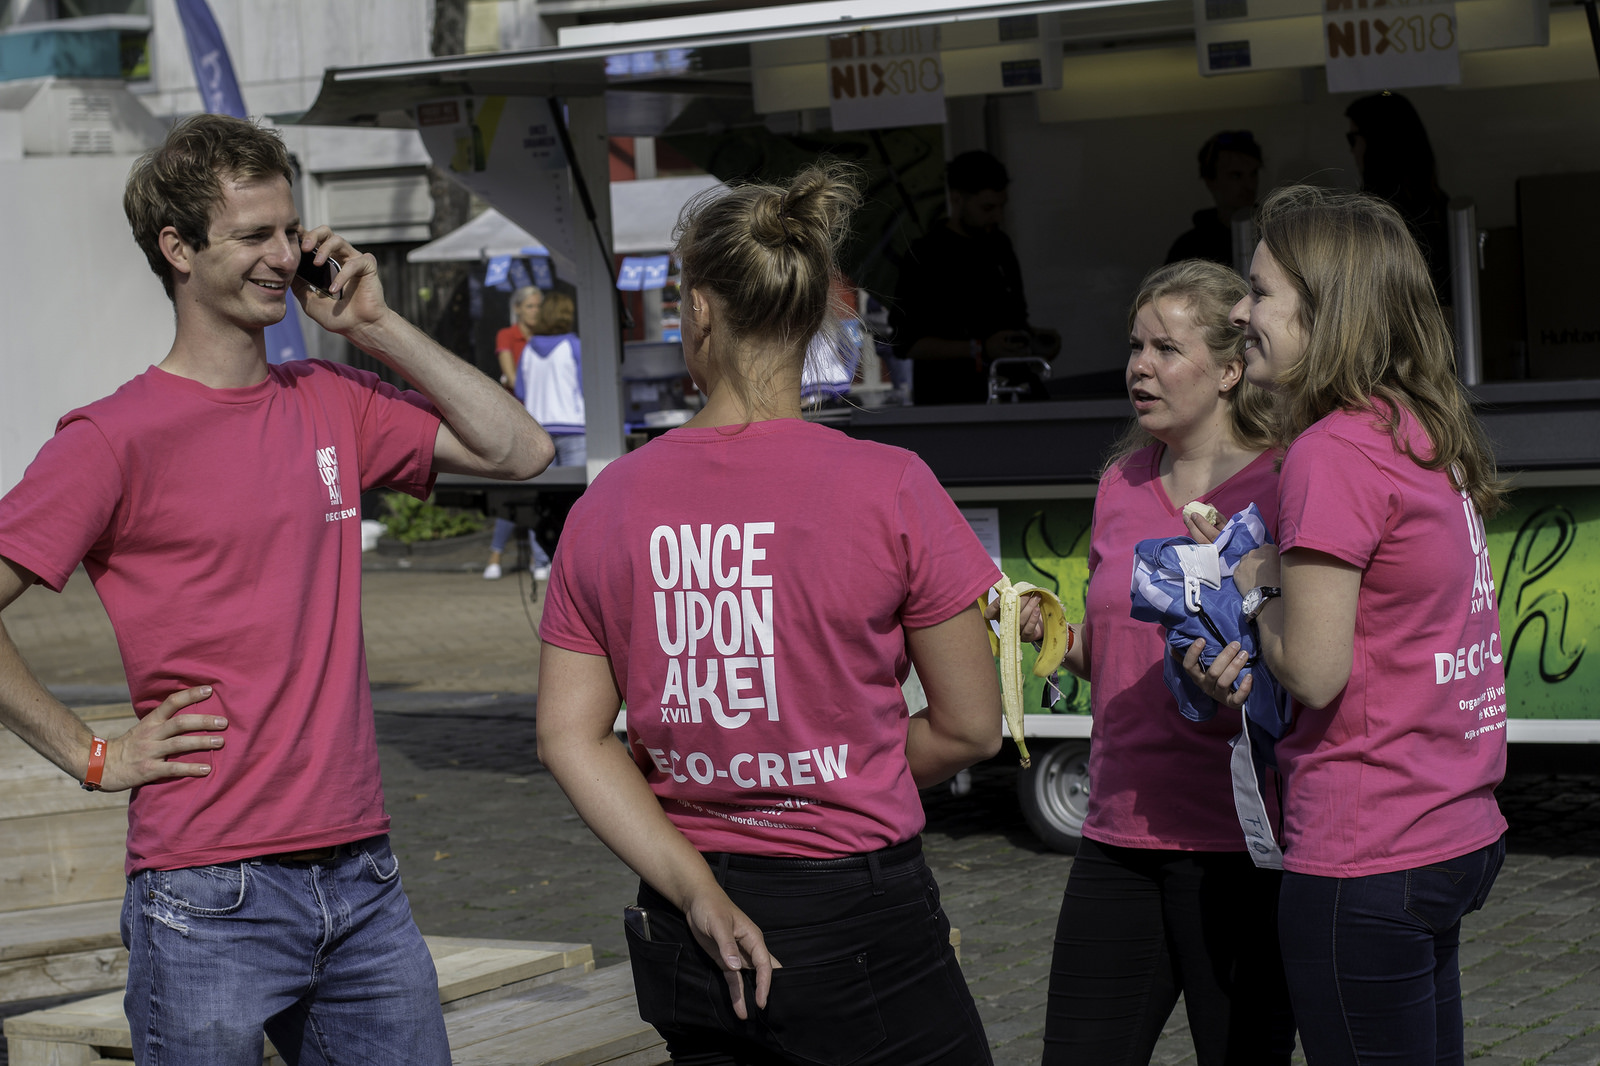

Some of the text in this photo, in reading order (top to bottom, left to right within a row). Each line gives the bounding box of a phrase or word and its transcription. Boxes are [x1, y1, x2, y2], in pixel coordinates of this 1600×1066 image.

[1327, 13, 1455, 59] NIX18
[831, 57, 940, 99] NIX18
[650, 521, 775, 590] ONCE
[653, 589, 774, 657] UPON
[660, 707, 690, 723] XVII
[1486, 686, 1497, 702] jij
[1480, 718, 1507, 734] www.wo
[646, 743, 849, 789] ECO-CREW
